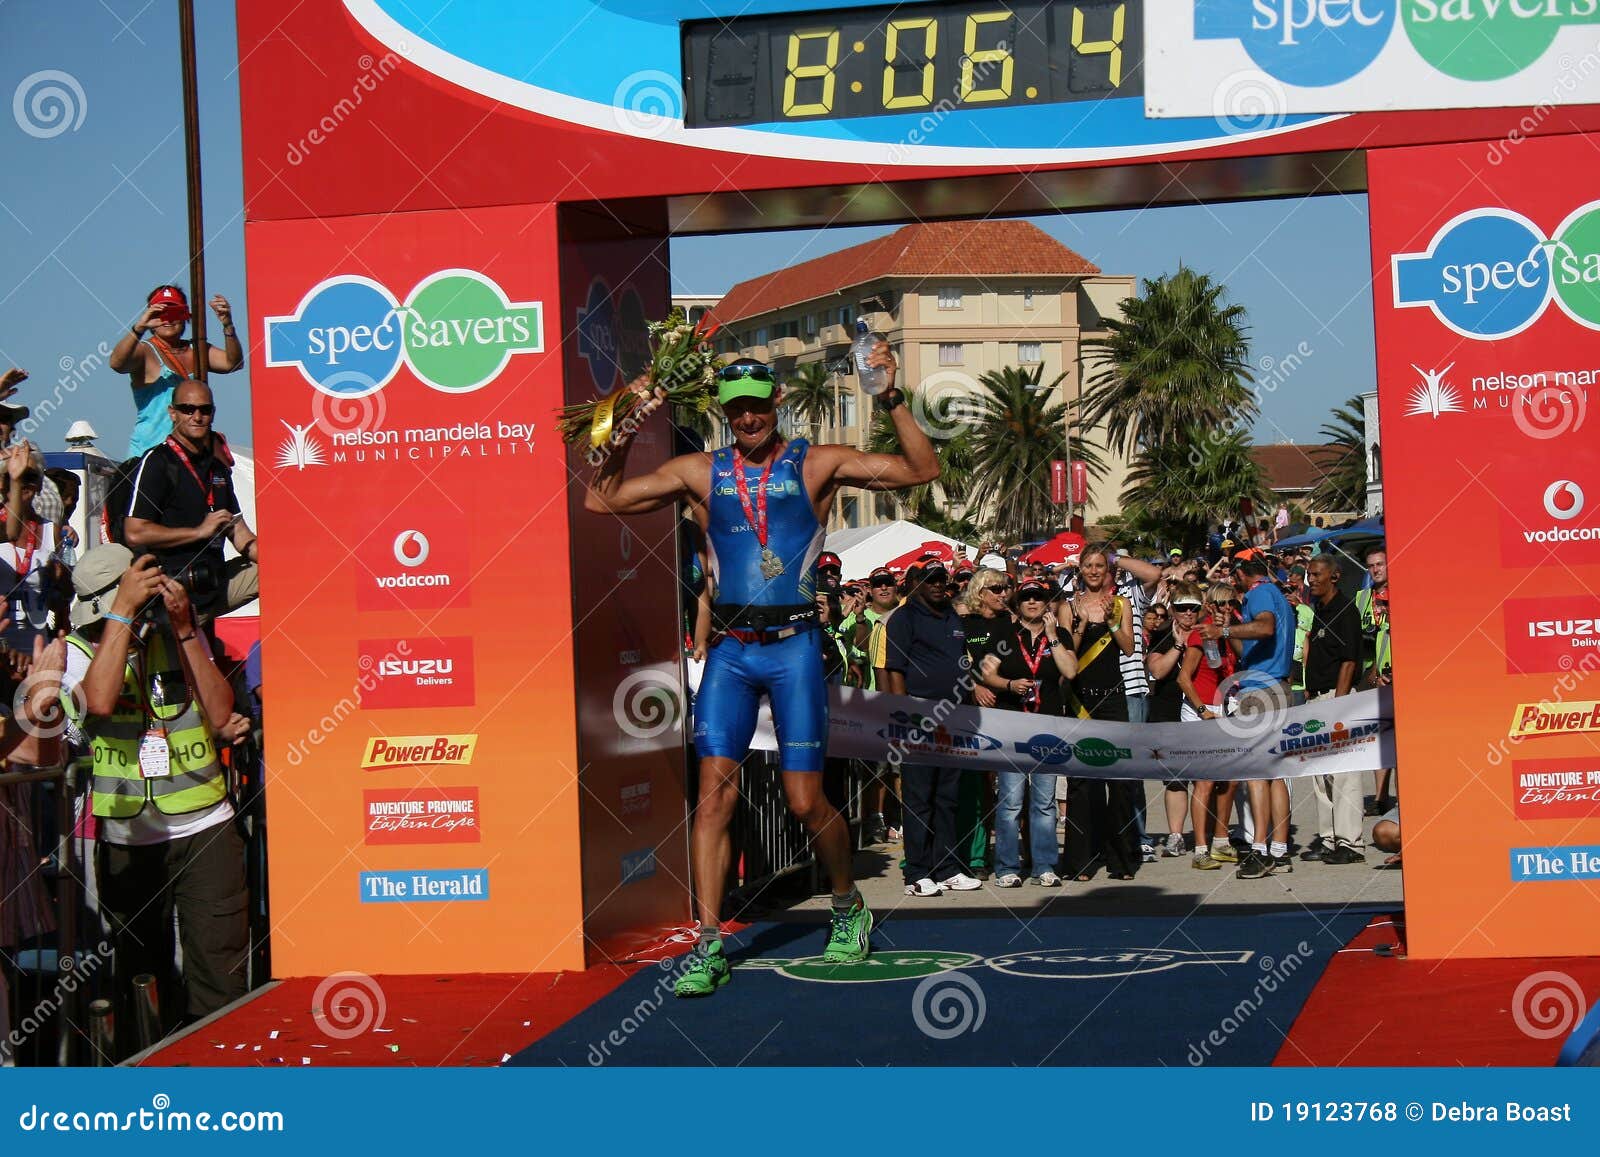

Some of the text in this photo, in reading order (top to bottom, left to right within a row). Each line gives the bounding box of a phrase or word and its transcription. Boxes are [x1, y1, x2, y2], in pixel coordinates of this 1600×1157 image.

[1252, 0, 1385, 45] spec
[1442, 259, 1541, 304] spec
[308, 315, 530, 365] spec savers
[1472, 371, 1546, 391] nelson
[333, 421, 535, 447] nelson mandela bay
[334, 442, 535, 463] MUNICIPALITY
[376, 573, 450, 588] vodacom
[379, 659, 453, 676] ISUZU
[416, 677, 453, 686] Delivers
[370, 737, 469, 763] PowerBar
[1073, 744, 1129, 759] savers
[1520, 771, 1583, 788] ADVENTURE
[1520, 785, 1595, 804] Eastern
[369, 799, 474, 815] ADVENTURE PROVINCE
[369, 814, 475, 832] Eastern Cape
[1517, 853, 1564, 876] The
[366, 874, 483, 897] The Herald
